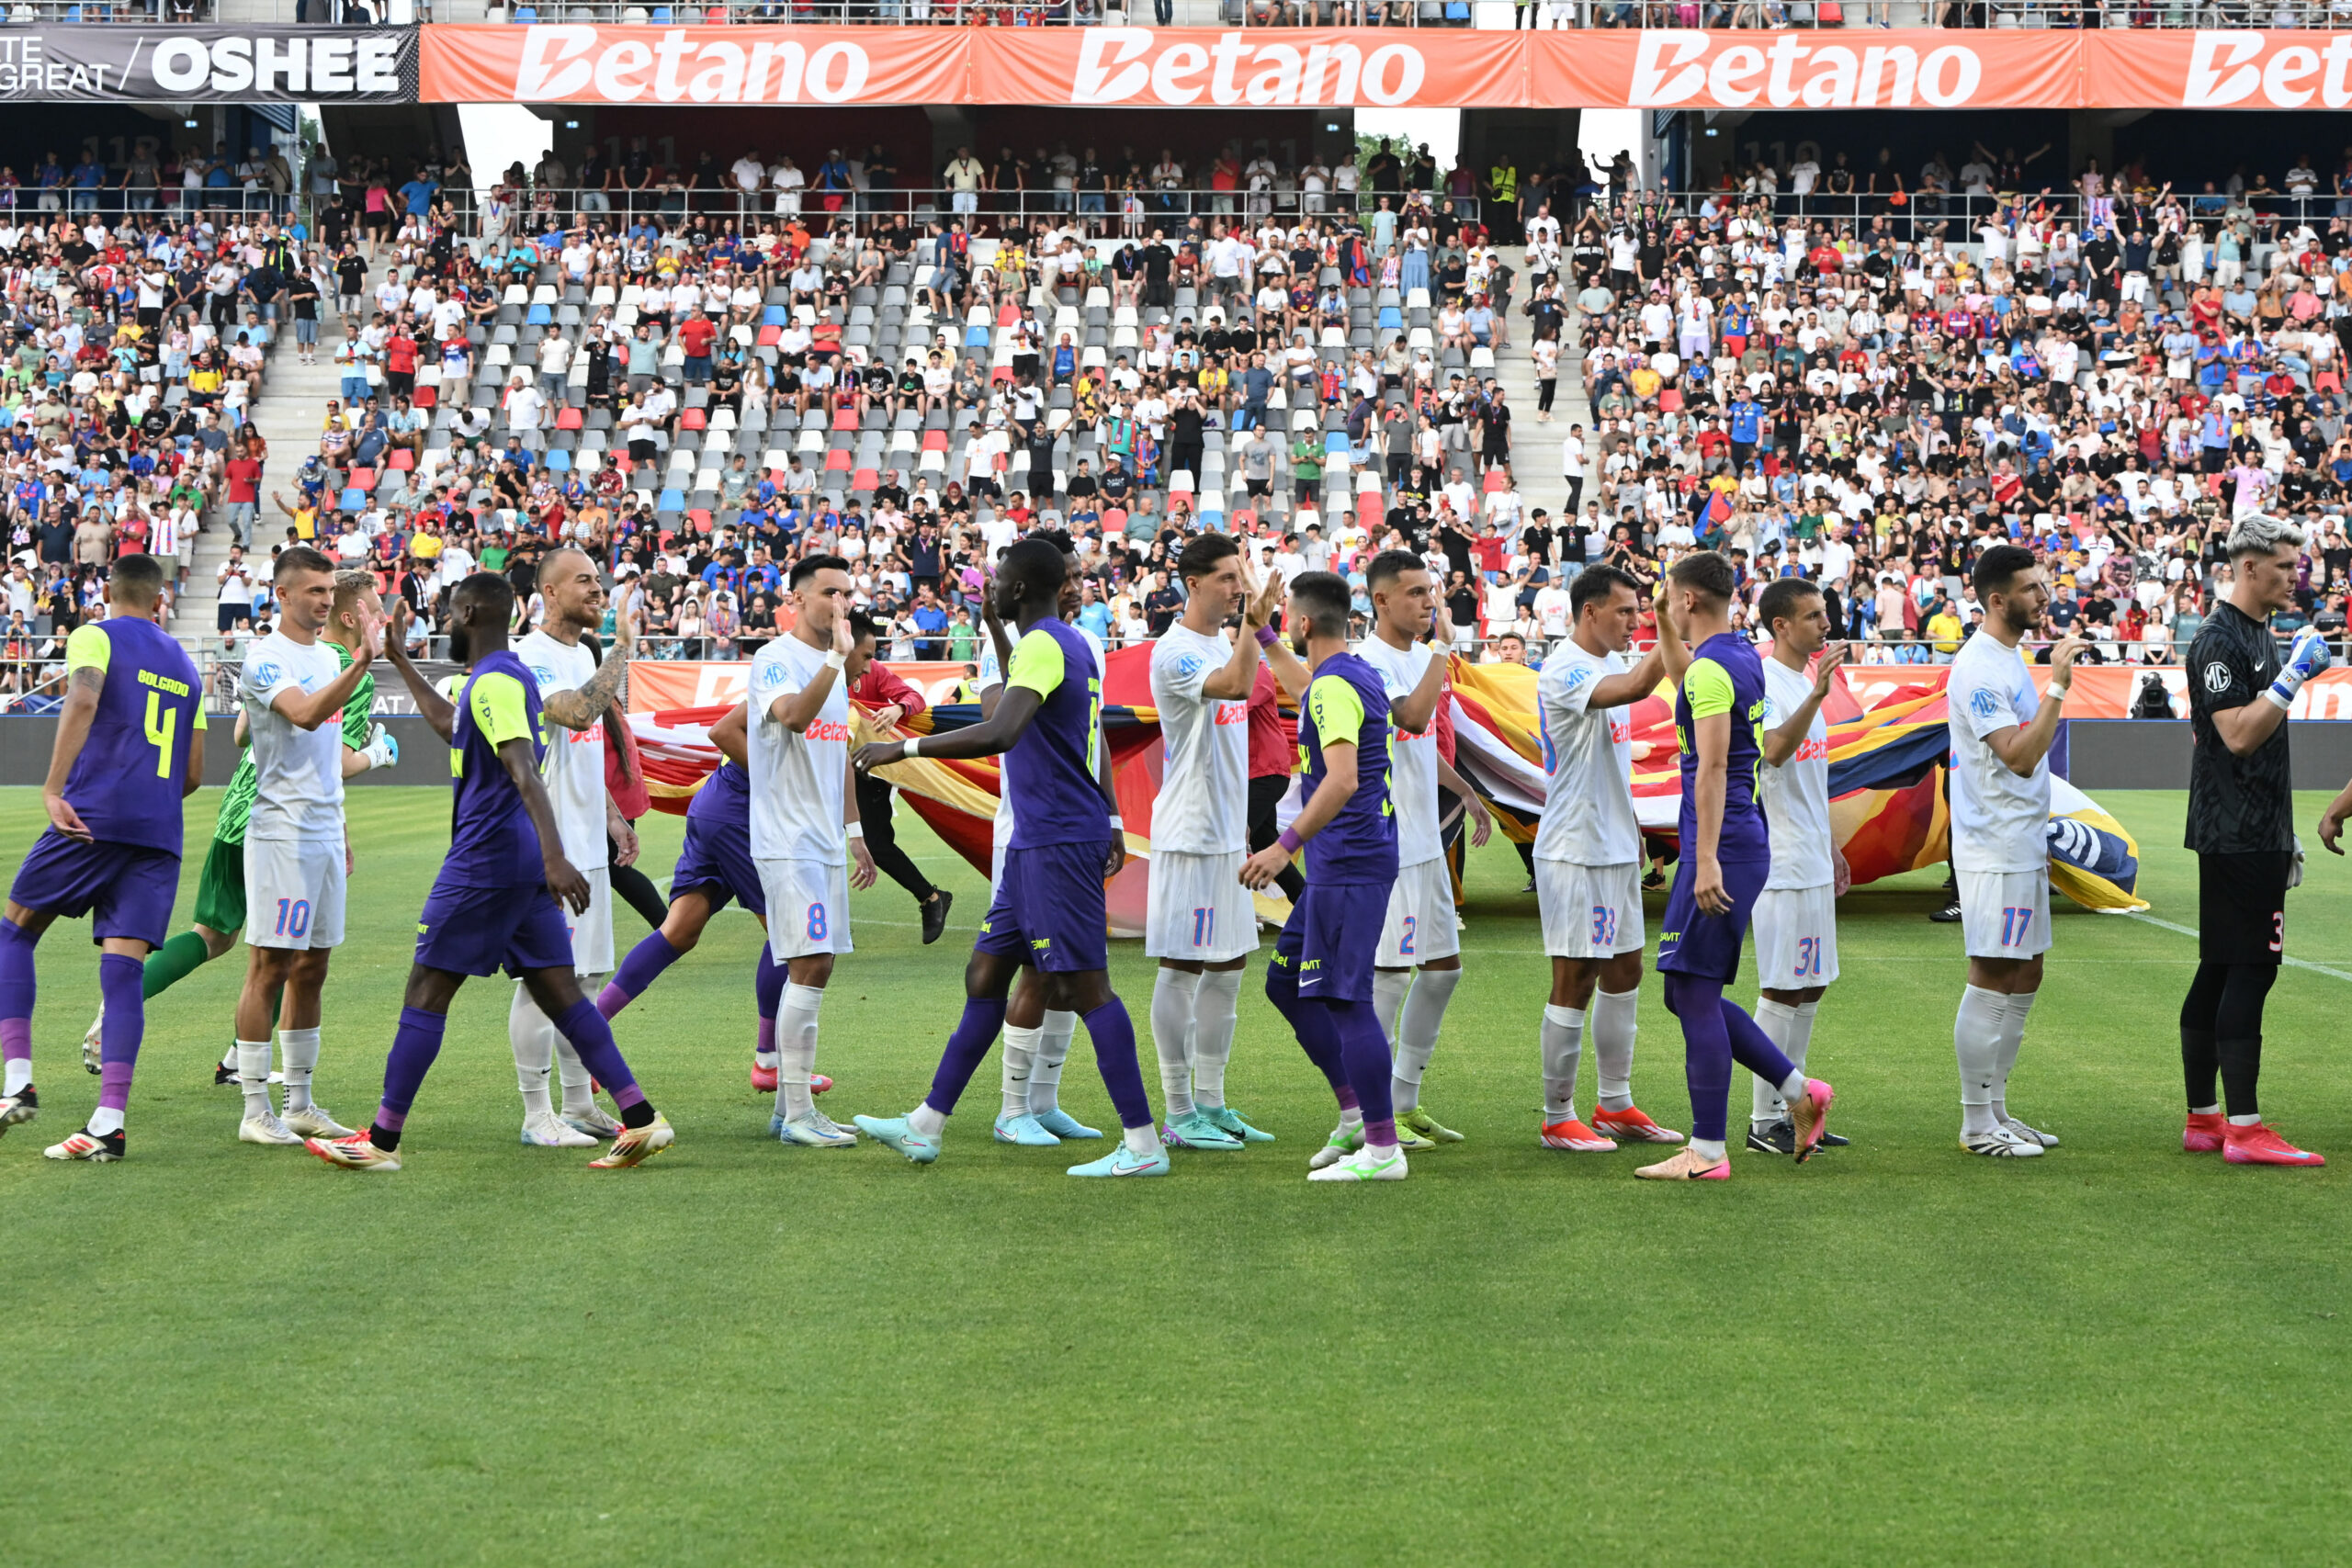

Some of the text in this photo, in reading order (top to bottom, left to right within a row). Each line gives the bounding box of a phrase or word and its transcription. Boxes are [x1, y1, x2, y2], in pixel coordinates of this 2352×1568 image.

[0, 36, 42, 63] TE
[151, 37, 400, 92] OSHEE
[514, 25, 870, 103] Betano
[1070, 28, 1425, 106] Betano
[1627, 30, 1982, 107] Betano
[0, 62, 112, 91] GREAT
[138, 669, 189, 697] BOLGADO
[2206, 663, 2230, 691] MG
[144, 691, 176, 779] 4
[276, 897, 311, 938] 10
[807, 902, 828, 942] 8
[1193, 907, 1214, 946] 11
[1592, 906, 1615, 946] 33
[2002, 907, 2033, 947] 17
[2268, 910, 2284, 952] 3
[1794, 936, 1821, 976] 31
